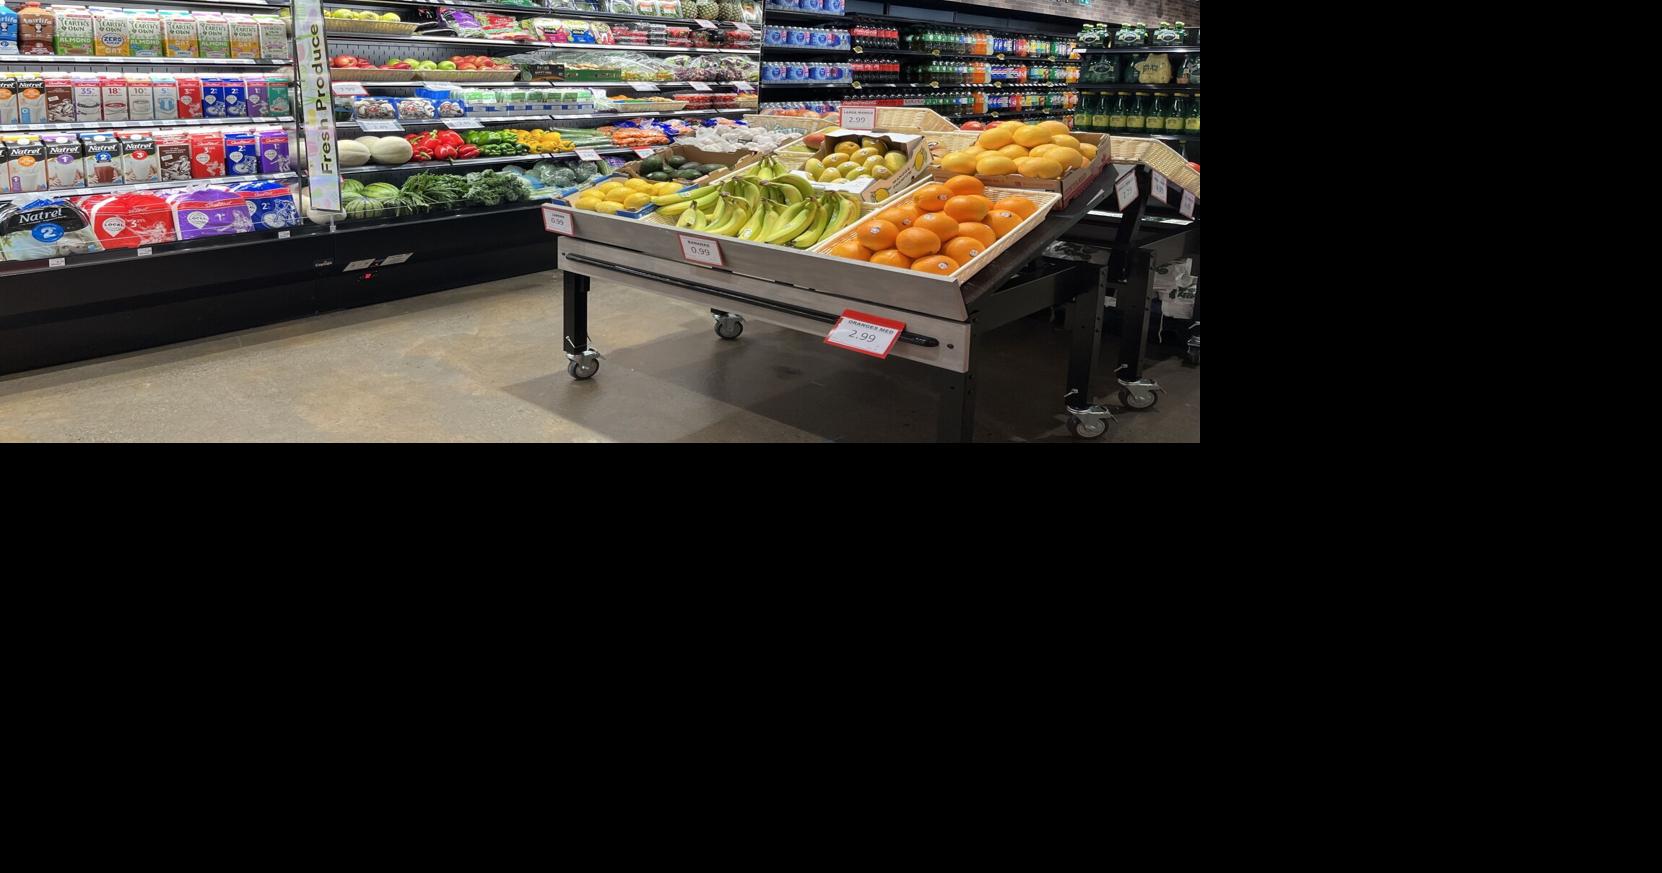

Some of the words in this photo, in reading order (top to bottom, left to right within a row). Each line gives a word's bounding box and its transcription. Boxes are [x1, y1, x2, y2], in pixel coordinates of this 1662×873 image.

[310, 24, 328, 111] Produce
[88, 144, 117, 152] Natrel
[318, 119, 332, 174] Fresh
[19, 207, 63, 224] Natrel
[40, 226, 57, 239] 2
[690, 246, 710, 256] 0.99
[848, 319, 879, 331] ORANGES
[880, 327, 894, 335] MED
[848, 329, 877, 343] 2.99
